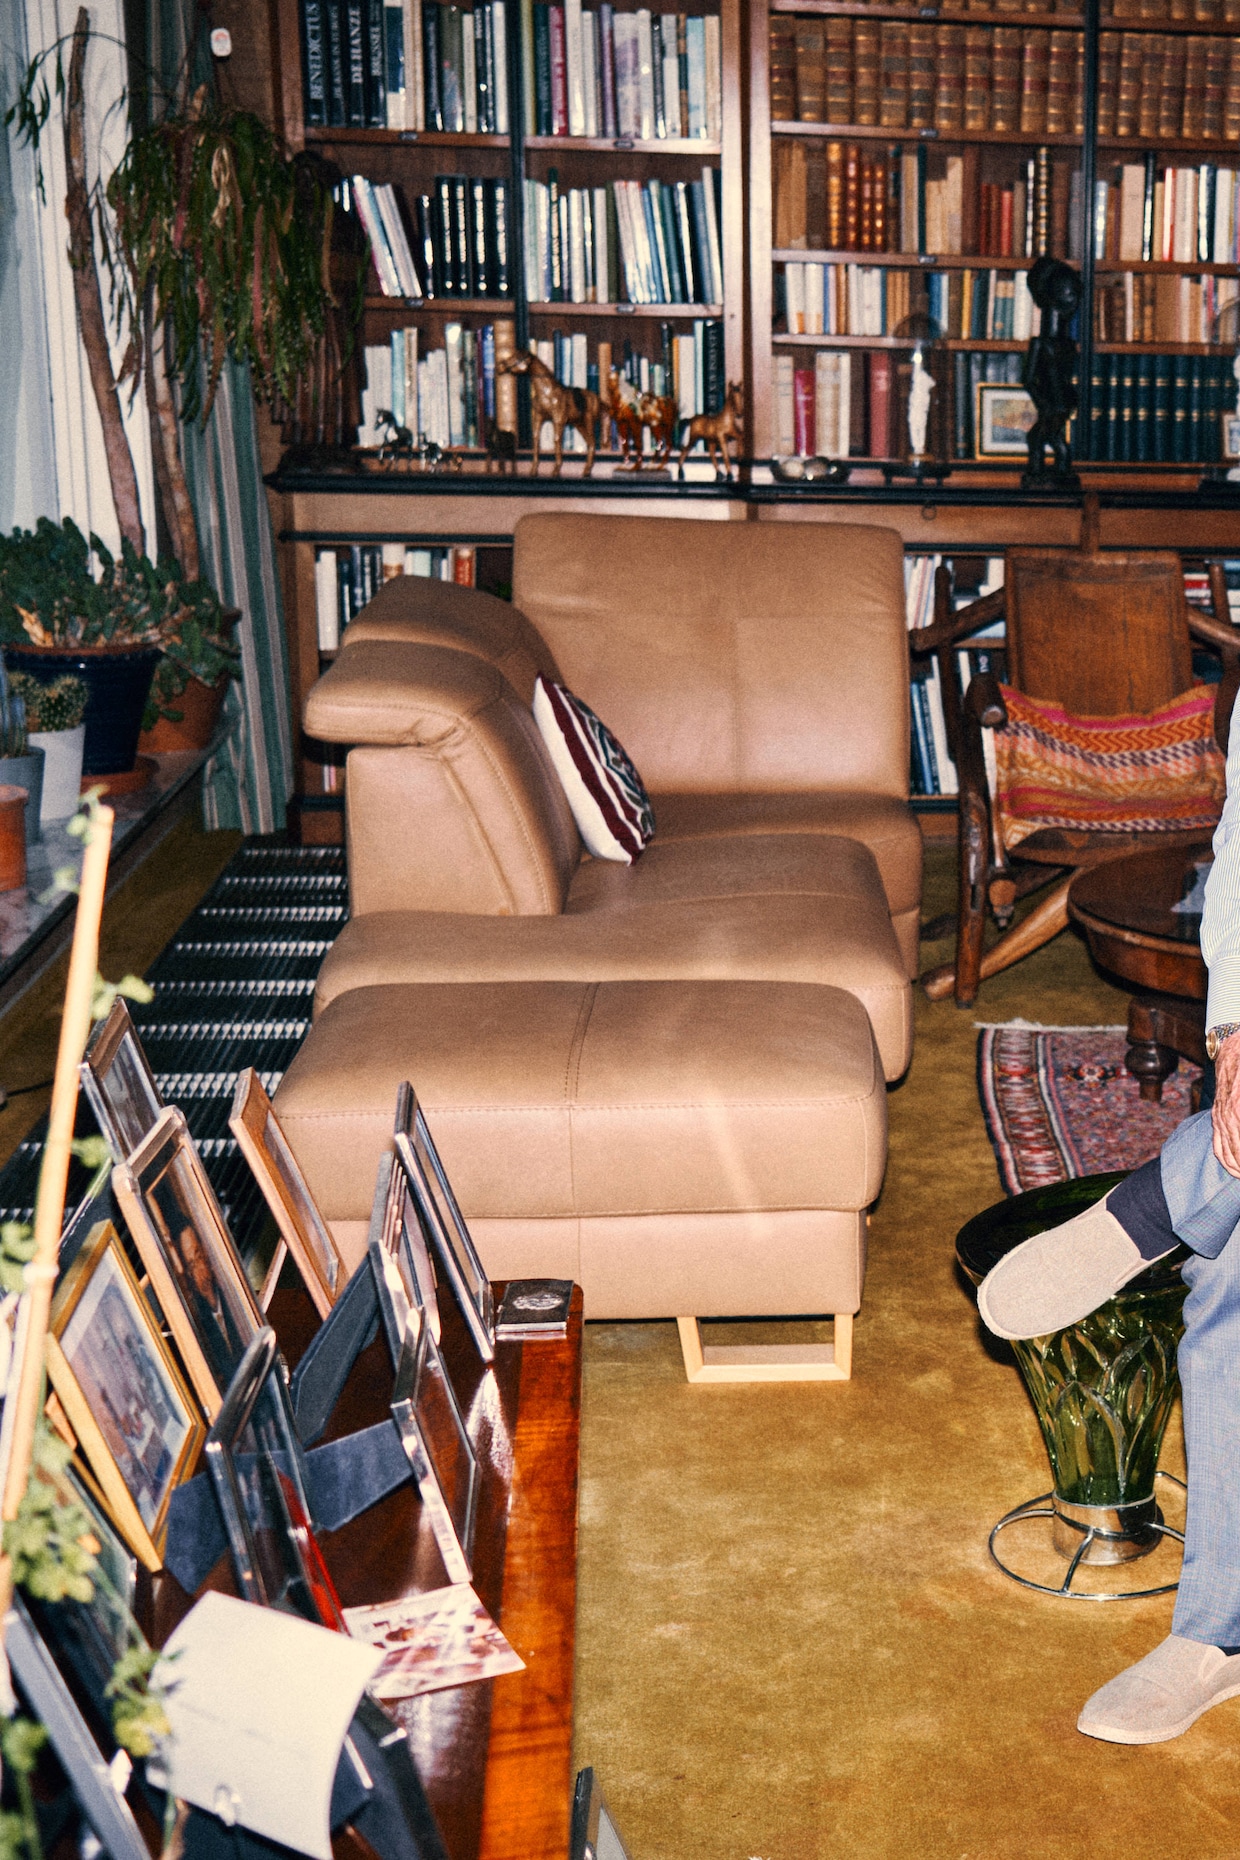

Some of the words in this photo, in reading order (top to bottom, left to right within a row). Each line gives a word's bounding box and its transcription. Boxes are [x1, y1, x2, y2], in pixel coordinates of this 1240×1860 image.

[305, 3, 324, 100] BENEDICTUS
[348, 6, 363, 60] HANZE
[369, 25, 382, 77] BRUSSEL
[351, 64, 363, 84] DE
